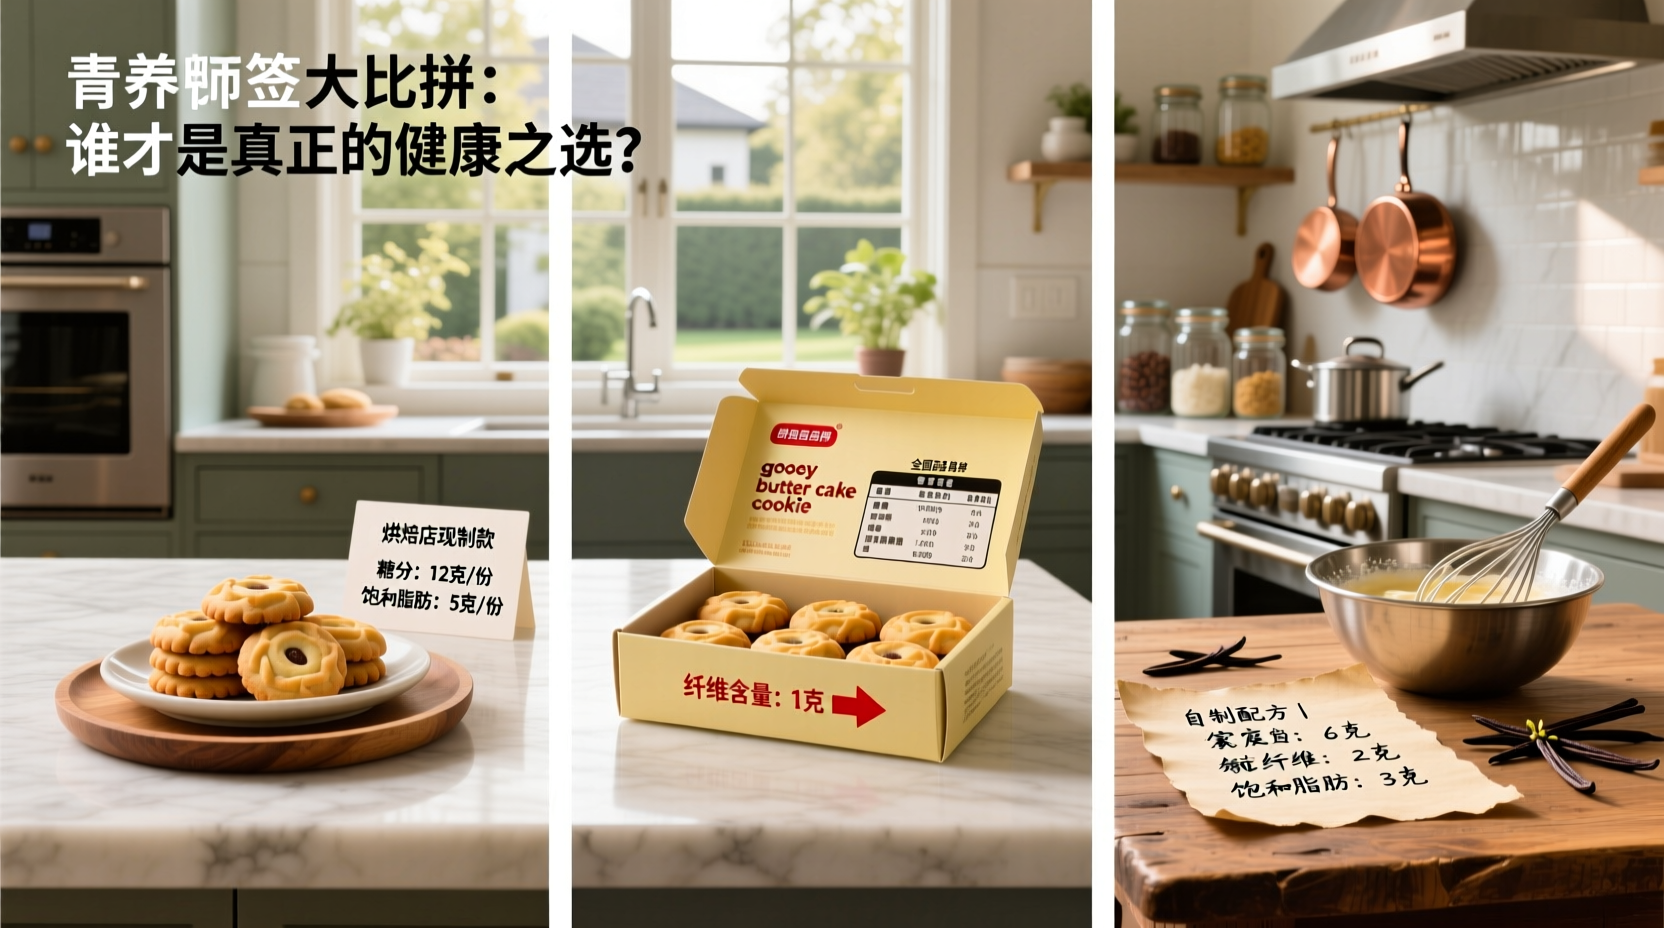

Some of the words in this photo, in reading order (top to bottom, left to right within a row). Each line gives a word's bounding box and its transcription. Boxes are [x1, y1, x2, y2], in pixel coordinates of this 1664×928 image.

[760, 462, 818, 480] gooey
[755, 477, 812, 496] butter
[815, 481, 857, 499] cake
[752, 495, 812, 514] cookie
[381, 521, 495, 550] 烘焙店现制款
